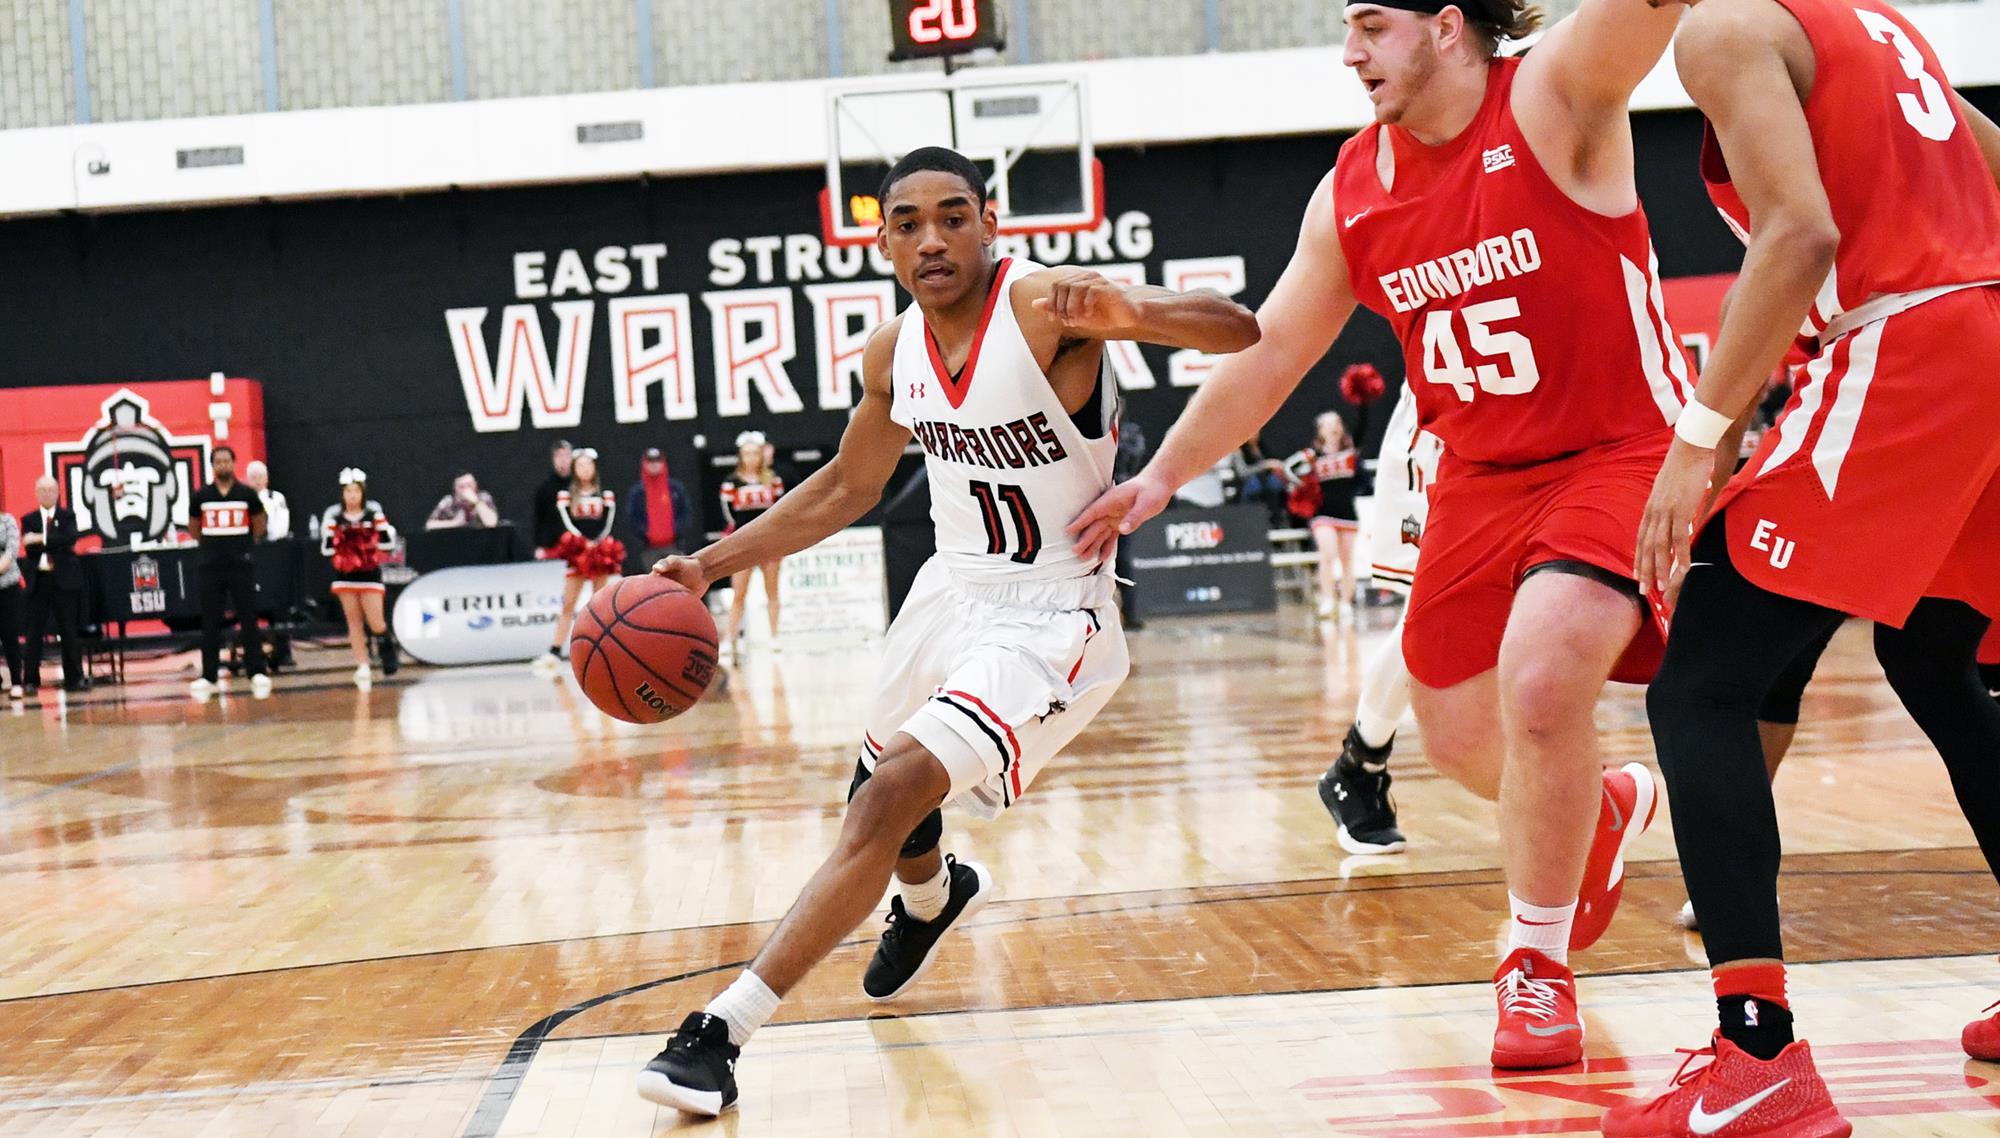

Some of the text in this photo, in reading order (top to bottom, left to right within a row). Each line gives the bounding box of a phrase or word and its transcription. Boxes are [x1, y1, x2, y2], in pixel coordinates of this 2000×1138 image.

[908, 0, 978, 43] 20
[1852, 8, 1957, 141] 3
[1483, 149, 1515, 168] PSAC
[513, 242, 667, 298] EAST
[1378, 228, 1542, 313] EDINBORO
[1422, 297, 1541, 402] 45
[913, 411, 1068, 469] WARRIORS
[969, 480, 1042, 564] 11
[1750, 518, 1796, 569] EU
[130, 590, 166, 613] ESU
